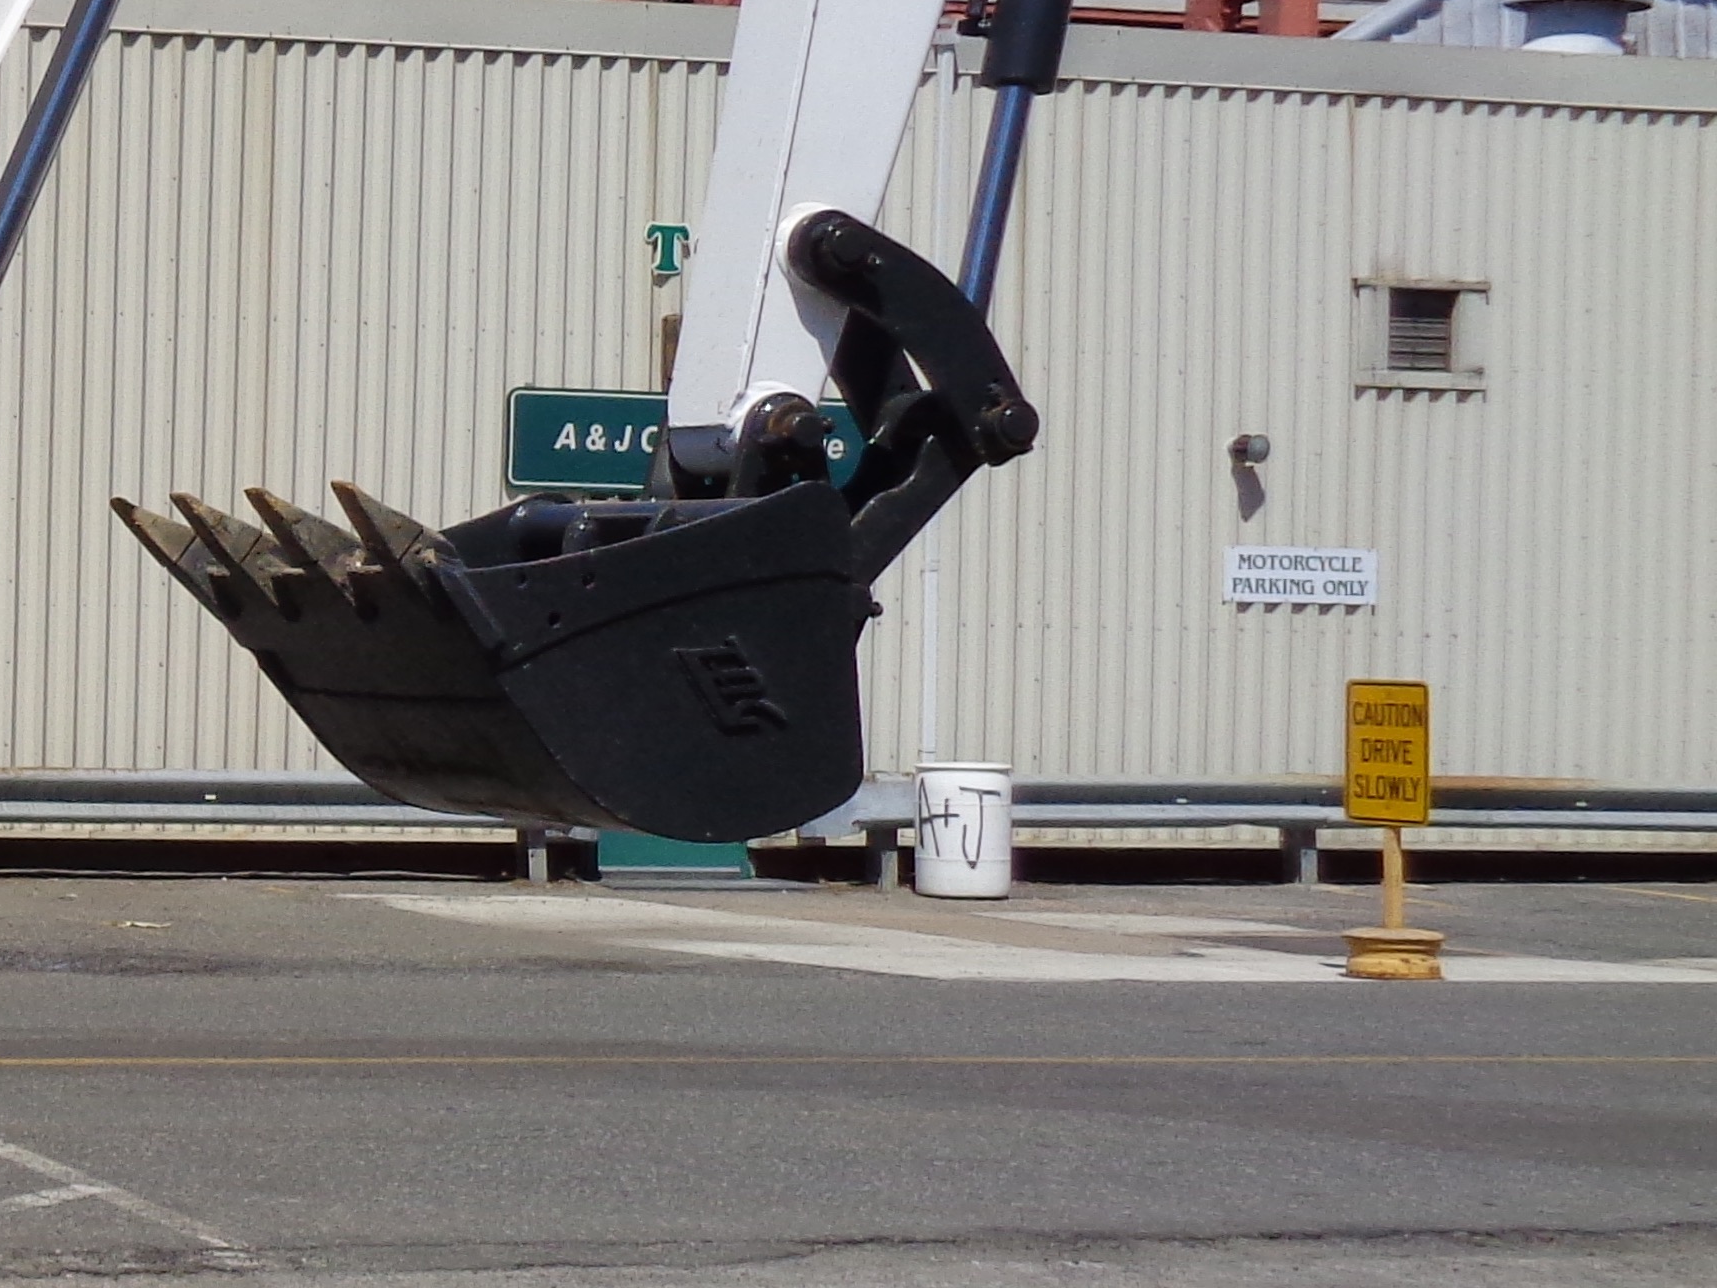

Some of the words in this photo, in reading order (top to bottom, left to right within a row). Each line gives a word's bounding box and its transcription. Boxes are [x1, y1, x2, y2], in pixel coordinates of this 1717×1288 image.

[1238, 553, 1363, 573] MOTORCYCLE
[1232, 577, 1314, 595] PARKING
[1323, 579, 1369, 596] ONLY
[1353, 701, 1423, 727] CAUTION
[1360, 738, 1413, 765] DRIVE
[1353, 774, 1422, 802] SLOWLY
